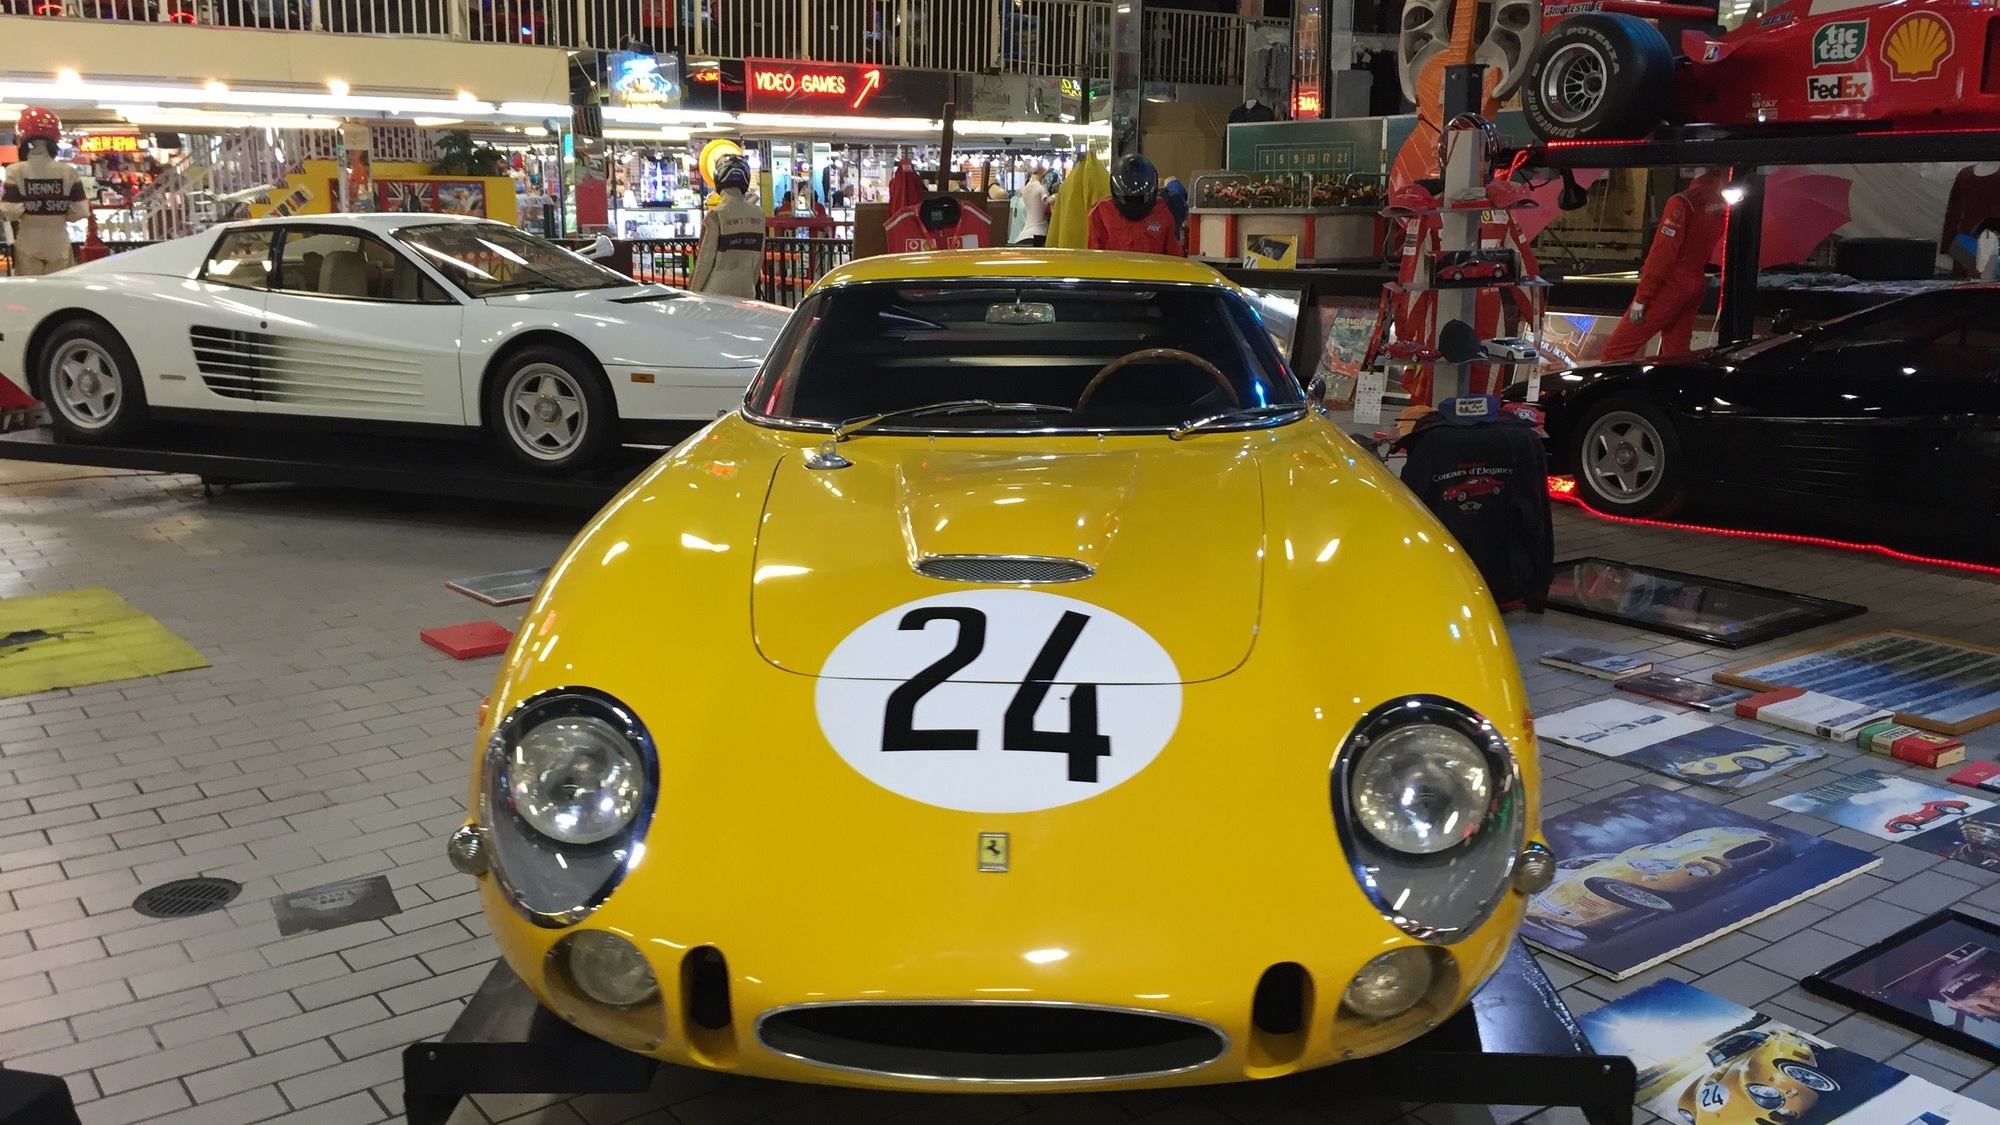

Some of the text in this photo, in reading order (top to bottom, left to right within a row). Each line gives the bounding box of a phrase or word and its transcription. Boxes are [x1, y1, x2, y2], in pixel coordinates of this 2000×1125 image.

[1826, 25, 1858, 45] tic
[1567, 27, 1620, 75] POTENZA
[1819, 39, 1857, 59] tac
[755, 71, 795, 92] VIDEO
[801, 74, 846, 94] GAMES
[1808, 76, 1867, 99] FedEx
[1528, 89, 1578, 139] BRIDGESTONE
[1265, 153, 1347, 164] 1 5 9 13 17 21
[27, 182, 62, 195] HENN'S
[1432, 470, 1467, 482] Concours
[881, 606, 1112, 783] 24
[1702, 1084, 1724, 1107] 24
